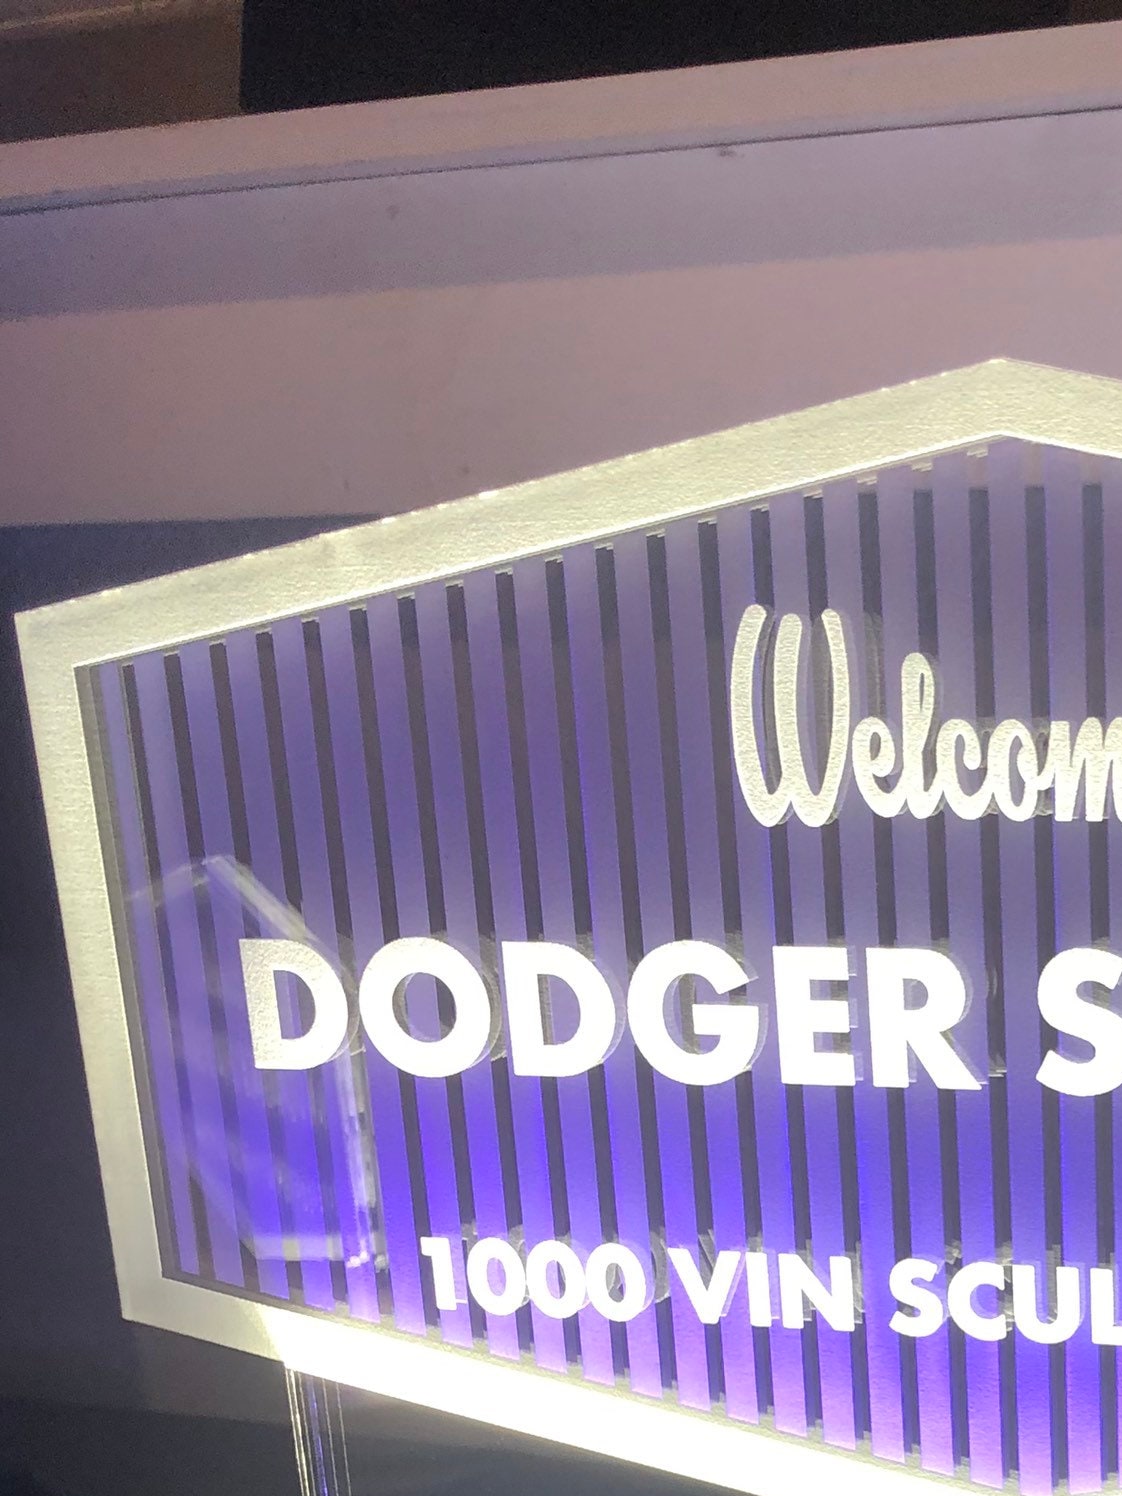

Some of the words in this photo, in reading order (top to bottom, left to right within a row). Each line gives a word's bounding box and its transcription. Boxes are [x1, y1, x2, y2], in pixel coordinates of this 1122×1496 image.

[239, 936, 983, 1091] DODGER
[420, 1236, 647, 1323] 1000
[668, 1244, 856, 1332] VIN
